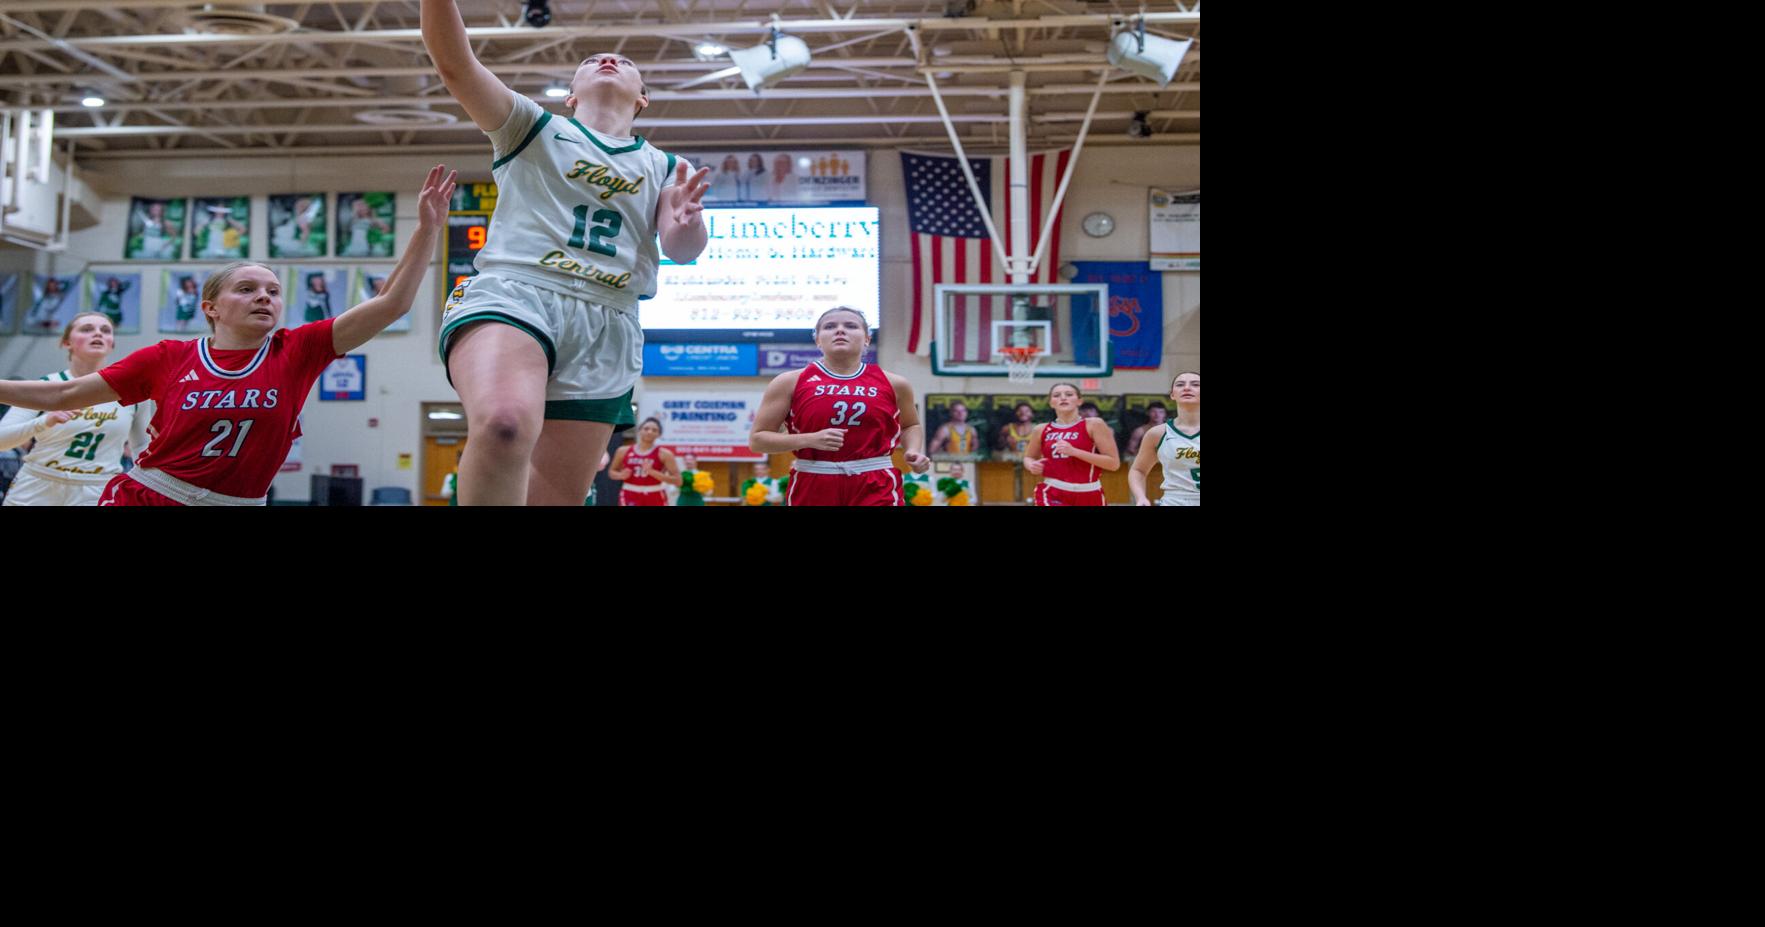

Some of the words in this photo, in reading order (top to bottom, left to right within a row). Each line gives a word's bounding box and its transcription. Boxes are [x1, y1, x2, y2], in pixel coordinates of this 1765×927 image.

[566, 159, 645, 200] Floyd
[467, 226, 487, 250] 9
[567, 204, 623, 258] 12
[709, 213, 879, 239] Limeberry
[539, 250, 632, 289] Central
[181, 388, 278, 410] STARS
[815, 384, 878, 397] STARS
[671, 411, 738, 421] PAINTING
[830, 400, 867, 426] 32
[64, 431, 106, 461] 21
[201, 419, 255, 457] 21
[1045, 431, 1079, 441] STARS
